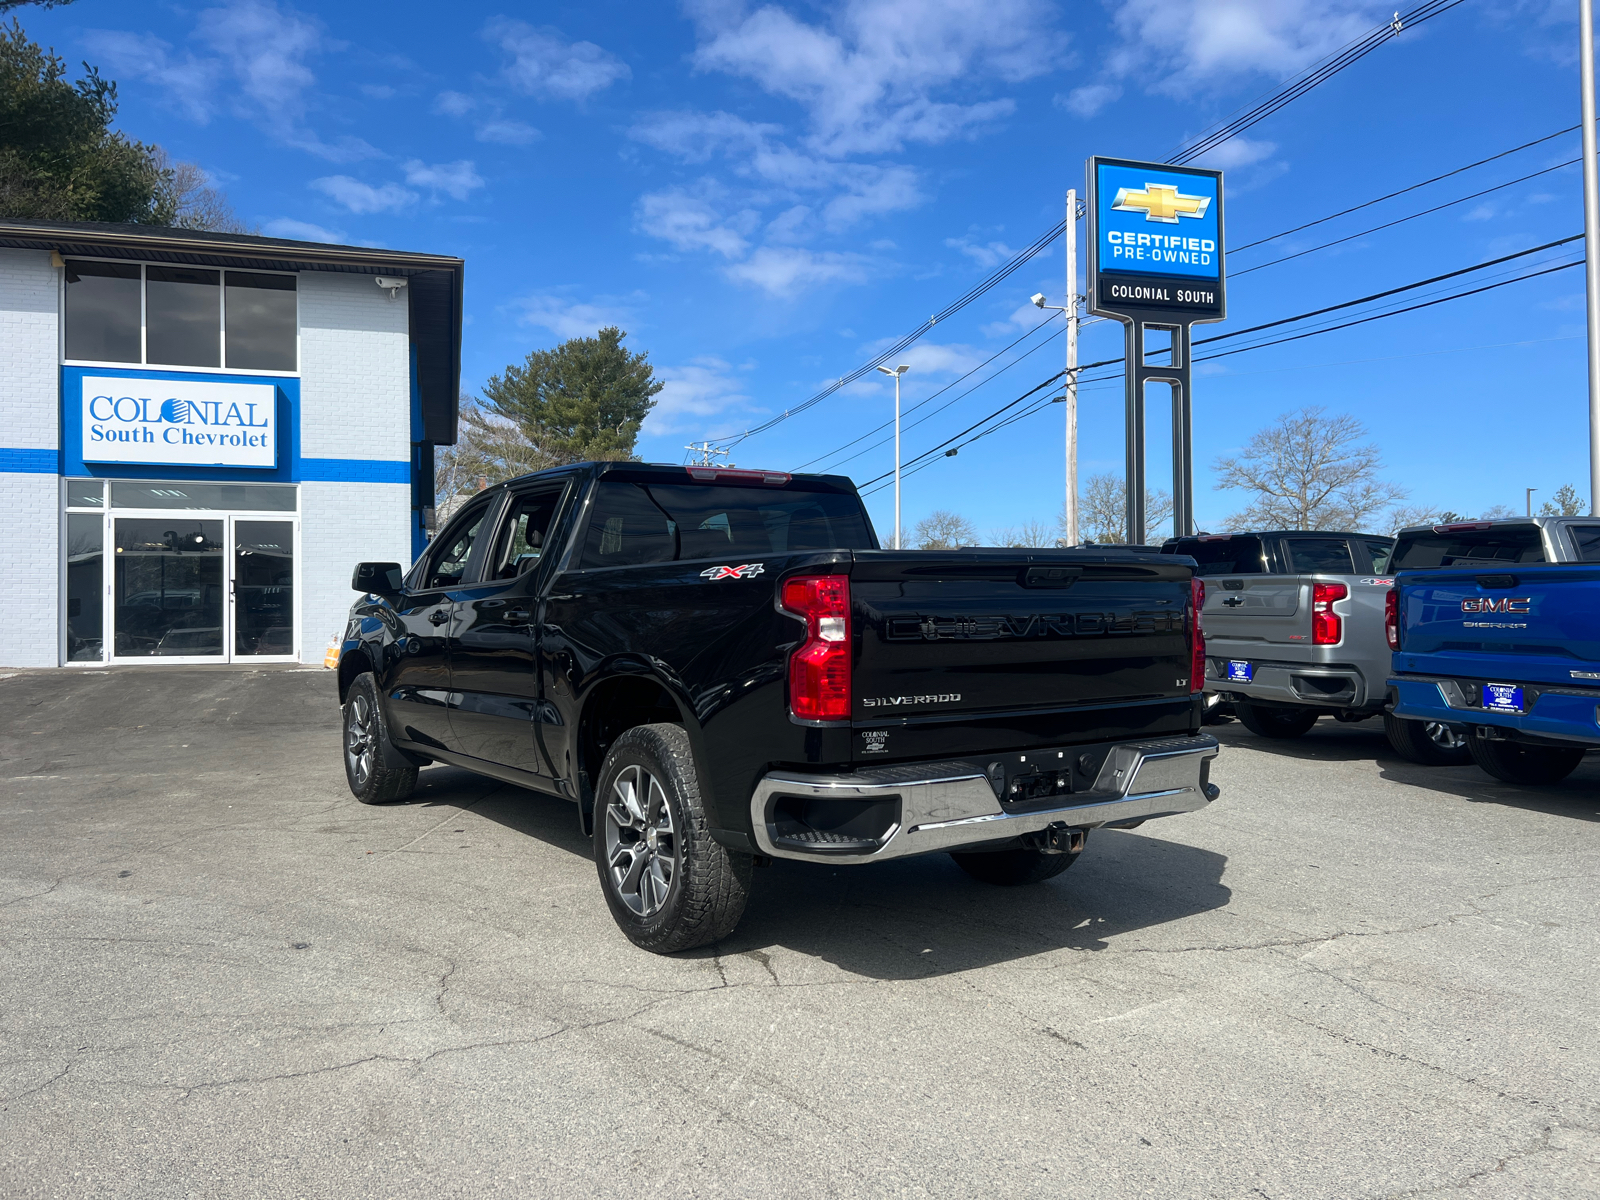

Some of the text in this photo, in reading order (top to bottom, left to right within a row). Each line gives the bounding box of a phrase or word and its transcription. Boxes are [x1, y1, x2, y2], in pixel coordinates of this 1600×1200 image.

[1107, 230, 1215, 253] CERTIFIED
[1113, 245, 1210, 266] PRE-OWNED
[1111, 285, 1214, 304] COLONIAL SOUTH
[89, 395, 268, 428] COLONIAL
[90, 424, 268, 448] South Chevrolet
[1461, 597, 1531, 614] GMC
[885, 611, 1183, 641] CHEVROLET
[1176, 678, 1188, 687] LT
[863, 693, 962, 707] SILVERADO
[861, 730, 890, 738] COLONIAL
[865, 736, 885, 744] SOUTH
